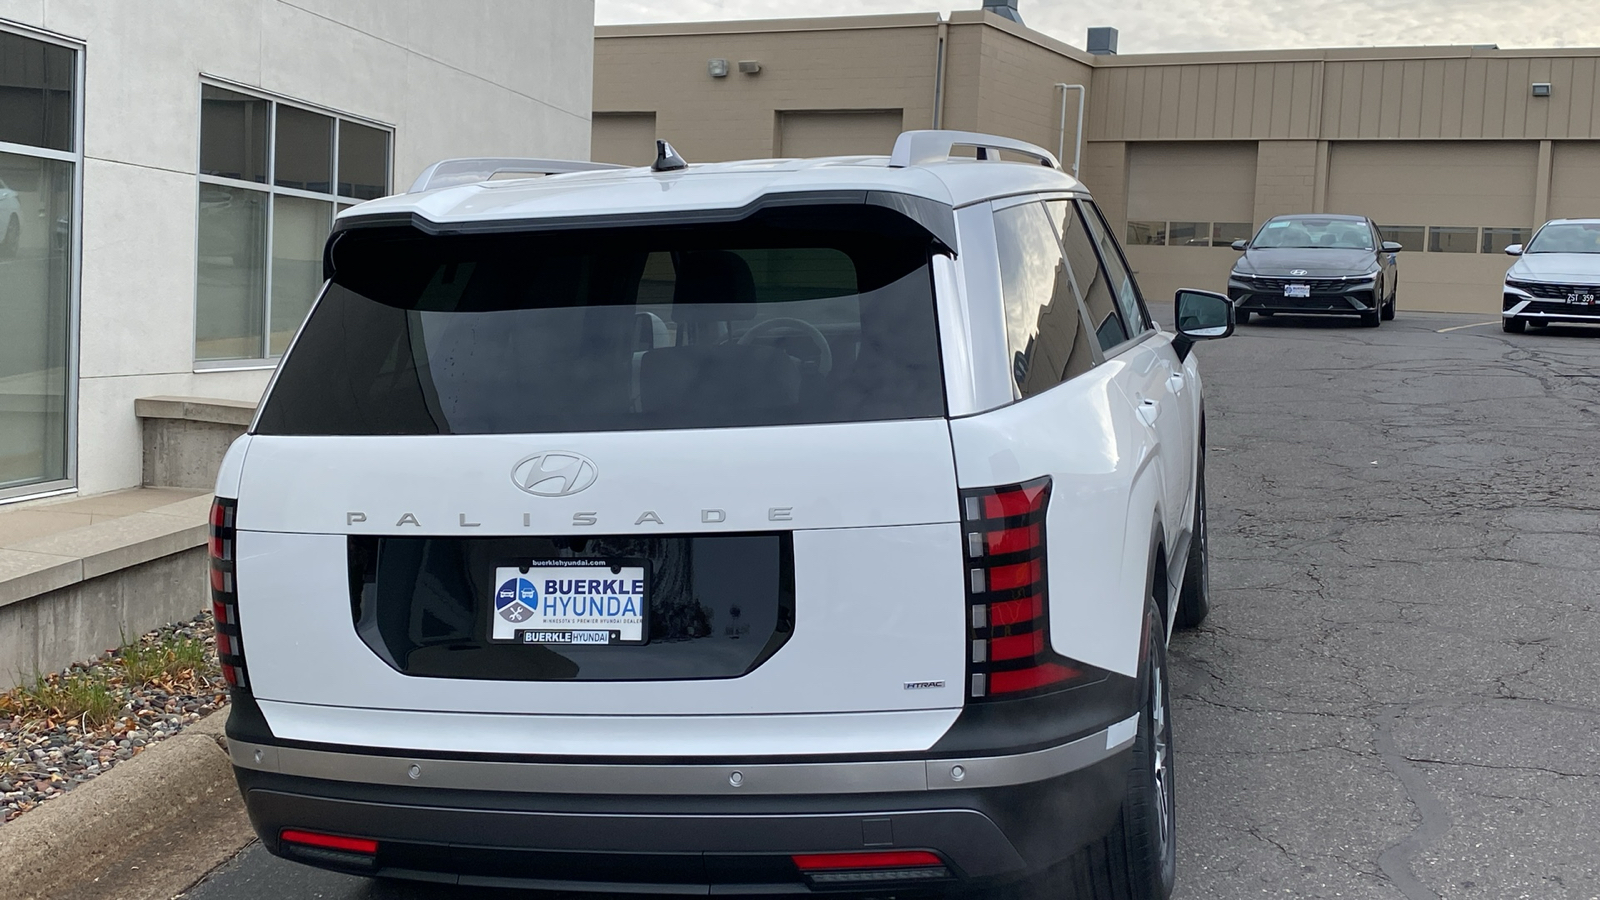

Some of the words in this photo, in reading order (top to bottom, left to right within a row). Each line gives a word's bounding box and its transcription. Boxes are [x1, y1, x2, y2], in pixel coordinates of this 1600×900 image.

[1582, 294, 1594, 302] 359
[346, 506, 794, 527] PALISADE
[532, 559, 606, 567] buerklehyundai.com
[544, 579, 643, 595] BUERKLE
[543, 596, 643, 617] HYUNDAI
[525, 632, 572, 642] BUERKLE
[573, 633, 608, 642] HYUNDAI
